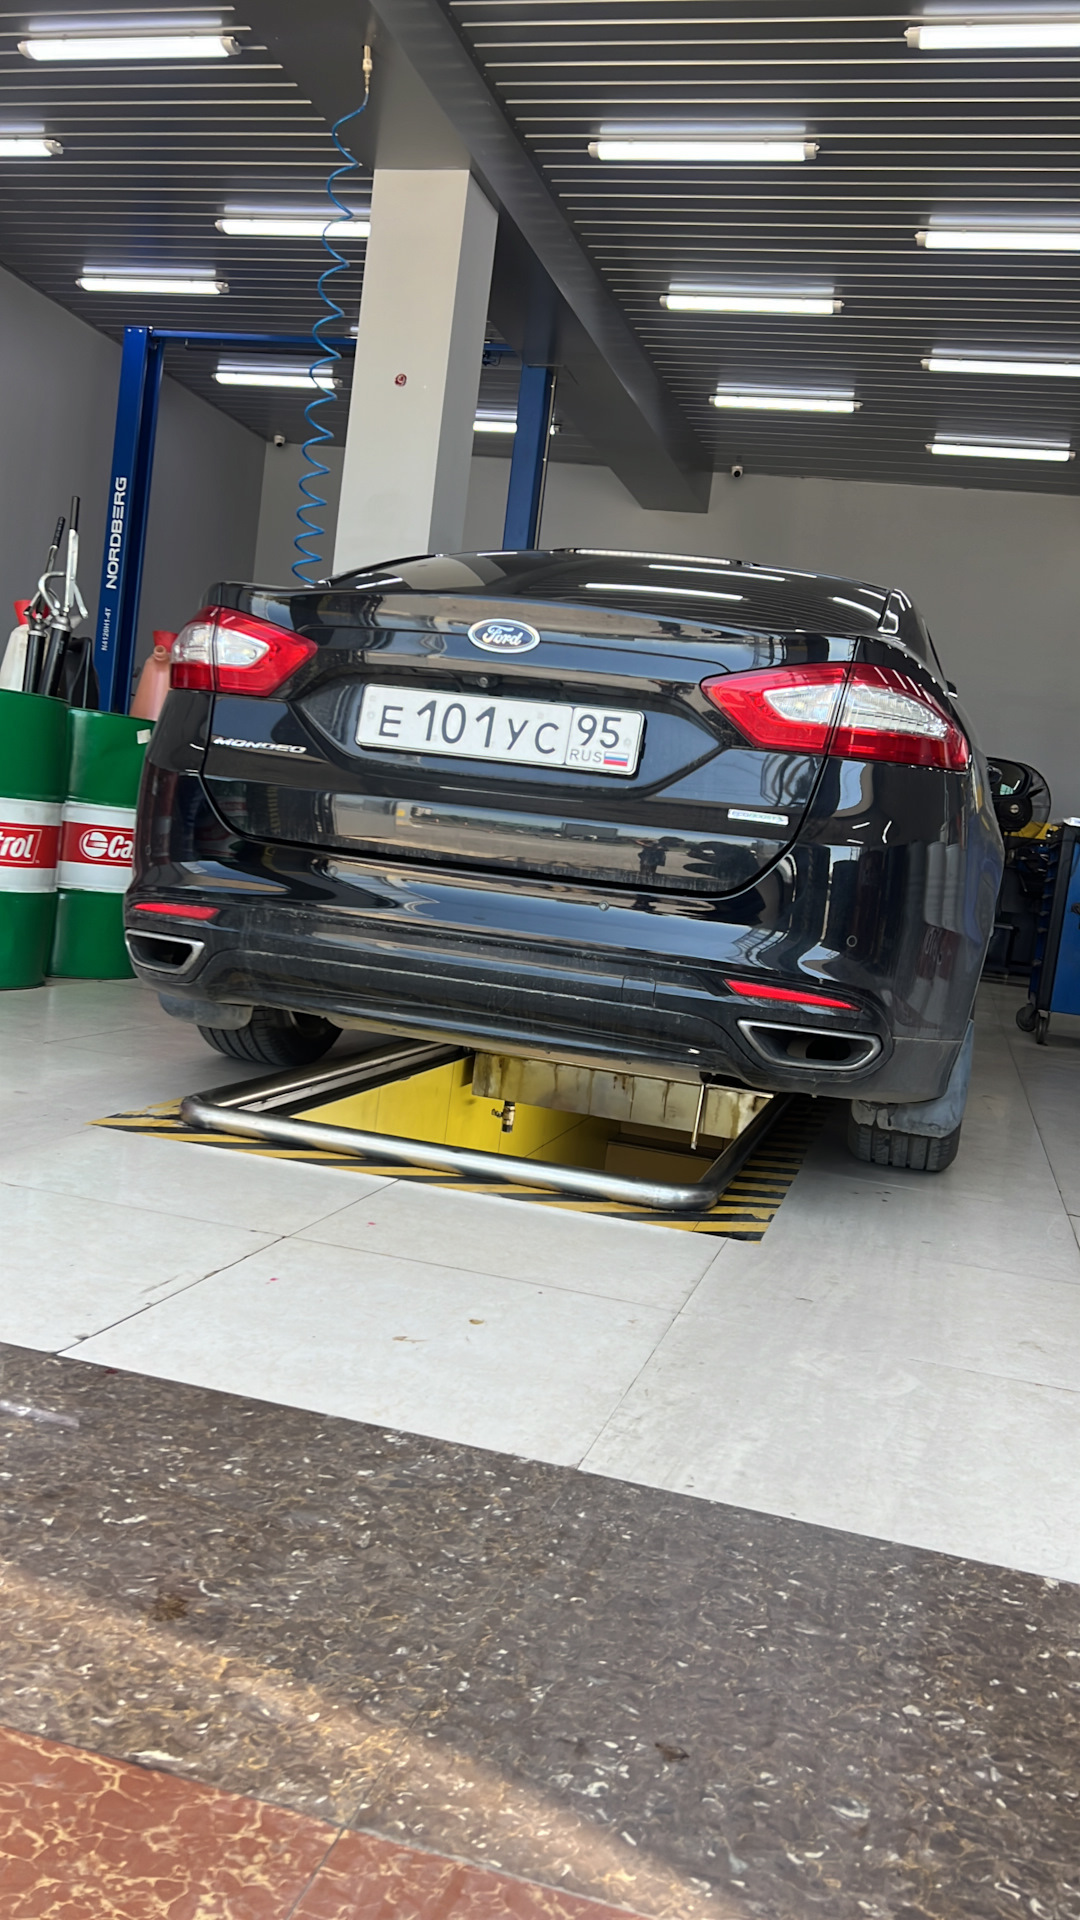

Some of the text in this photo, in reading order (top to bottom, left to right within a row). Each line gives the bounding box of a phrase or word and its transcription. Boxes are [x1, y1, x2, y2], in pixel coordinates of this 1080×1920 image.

[105, 477, 127, 589] NORDBERG
[482, 625, 523, 646] Ford
[577, 714, 622, 748] 95
[213, 737, 307, 754] MONDEO
[569, 748, 602, 763] RUS
[108, 835, 134, 858] Ca
